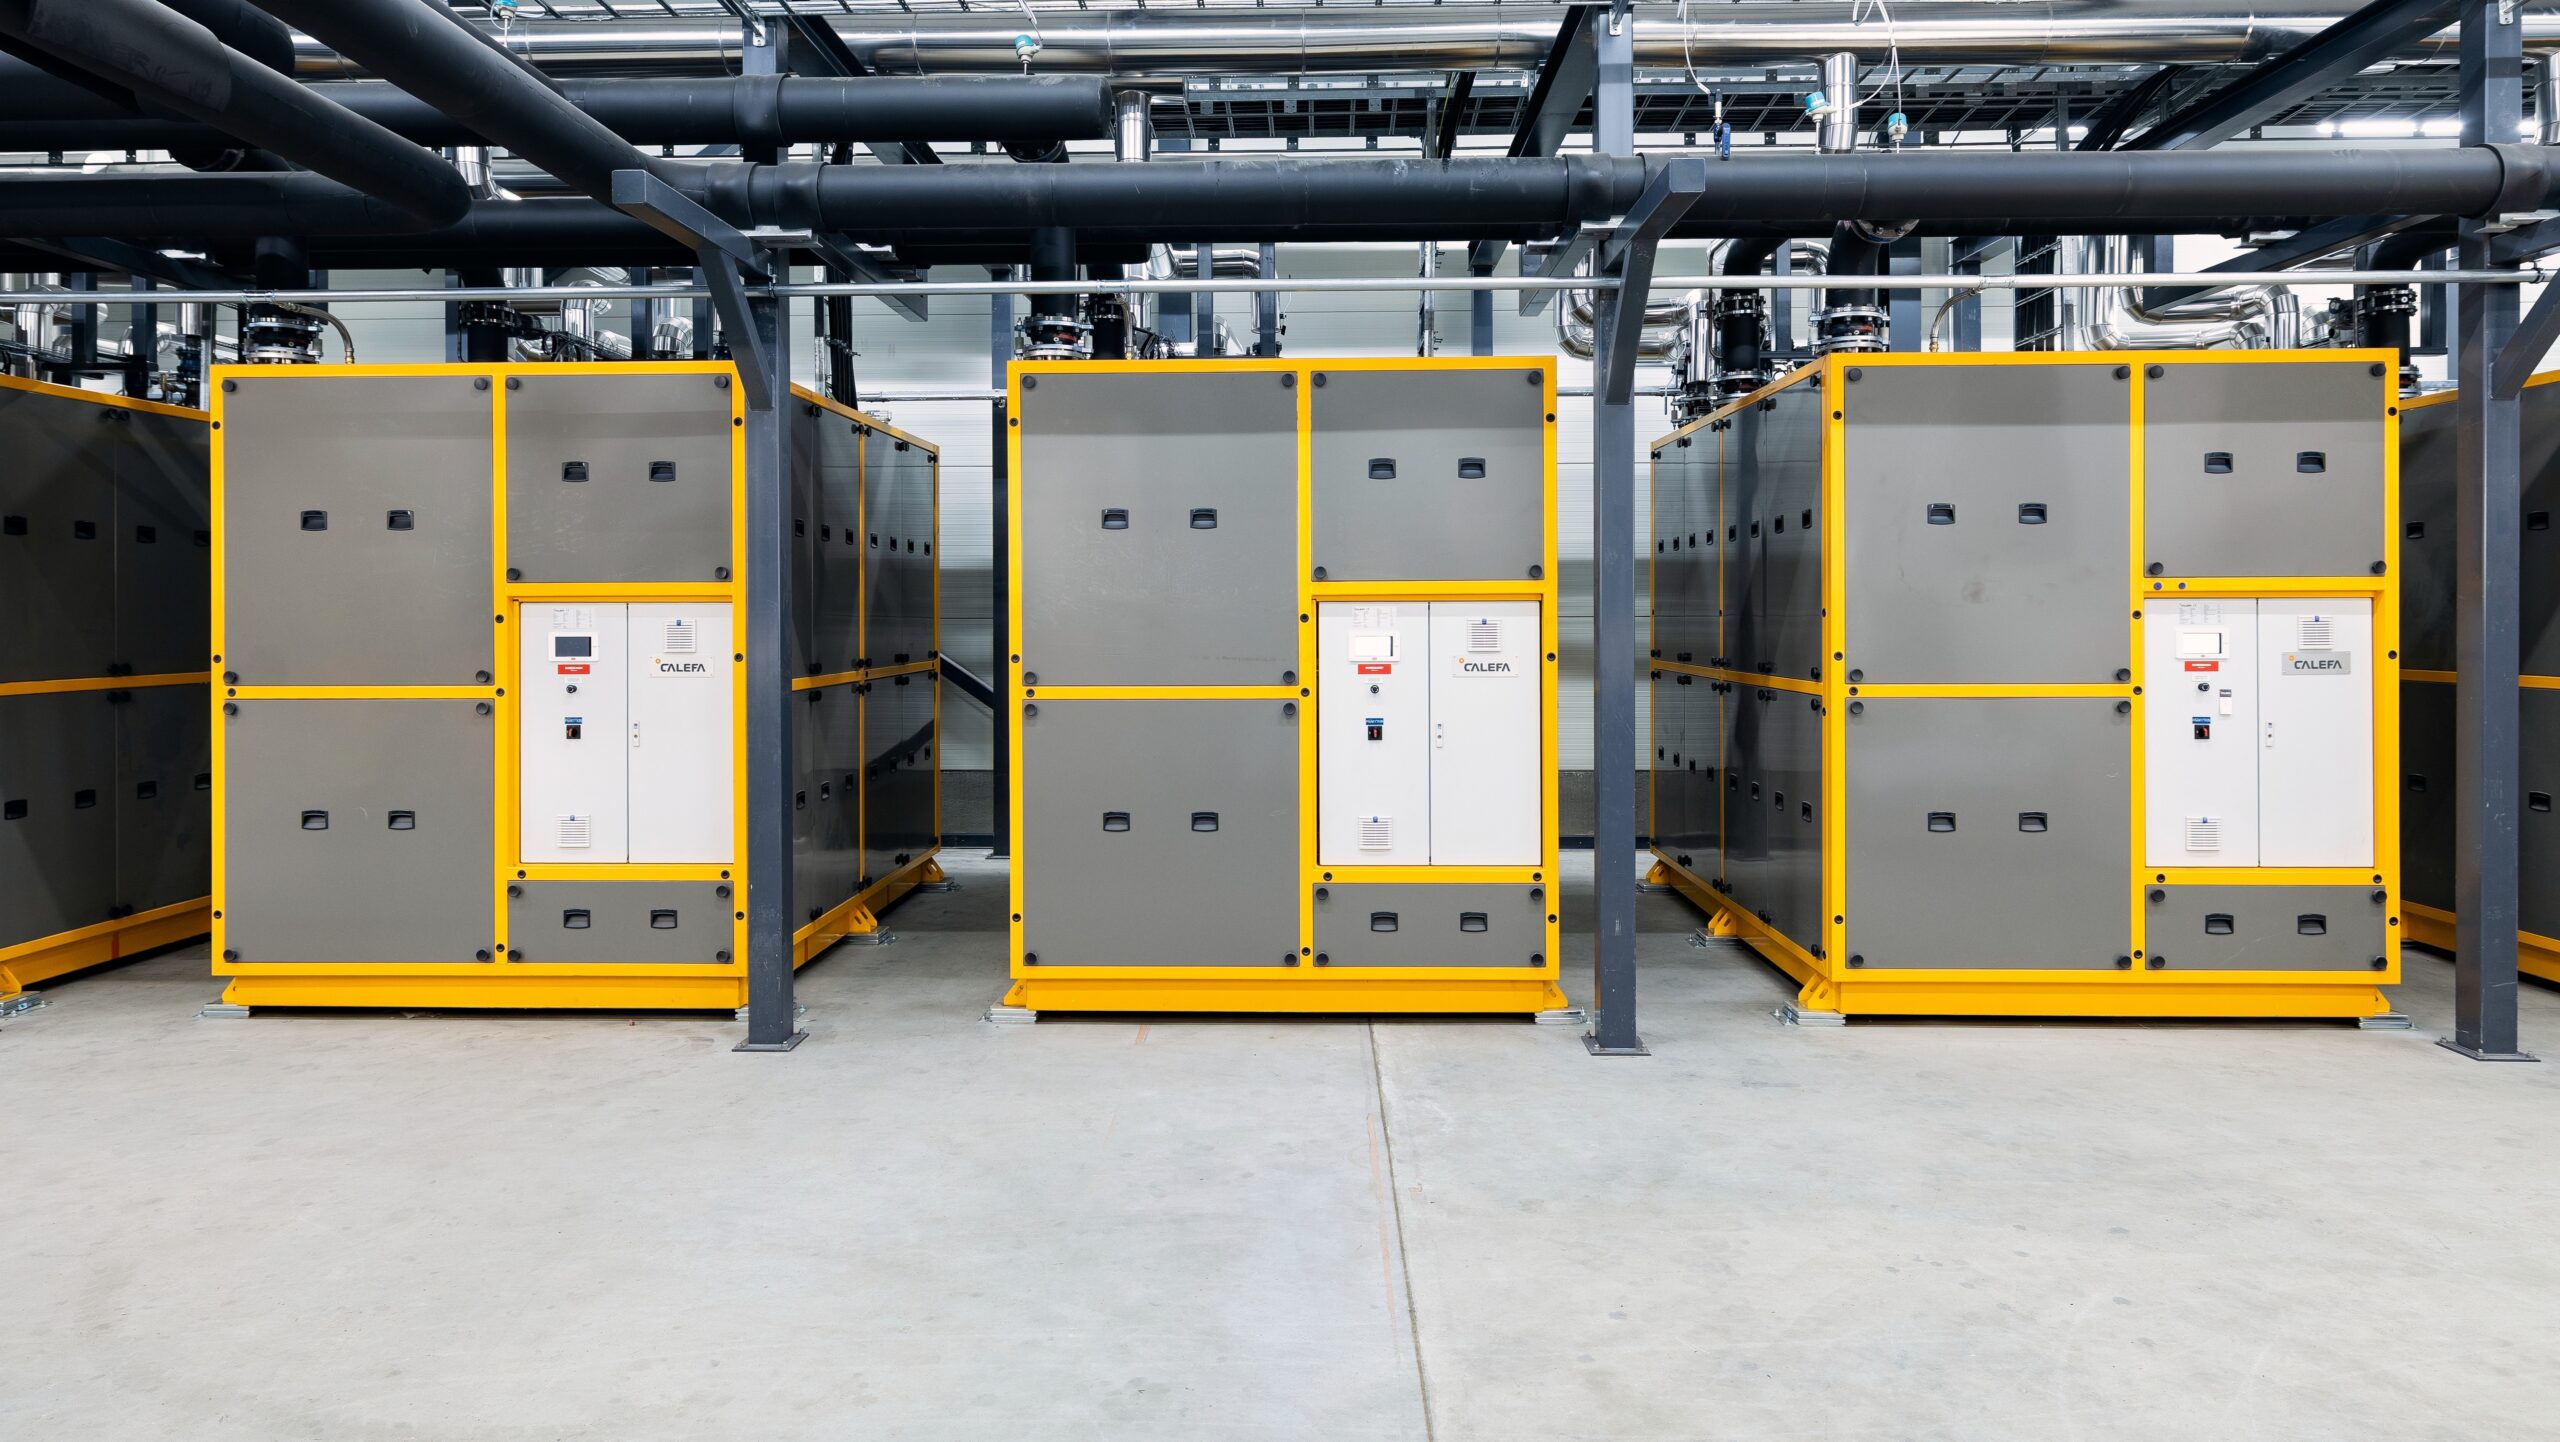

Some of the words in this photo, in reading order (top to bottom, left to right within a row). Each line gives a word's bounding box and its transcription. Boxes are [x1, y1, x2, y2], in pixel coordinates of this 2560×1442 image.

[660, 663, 706, 673] CALEFA
[1464, 662, 1511, 672] CALEFA
[2294, 660, 2342, 669] CALEFA
